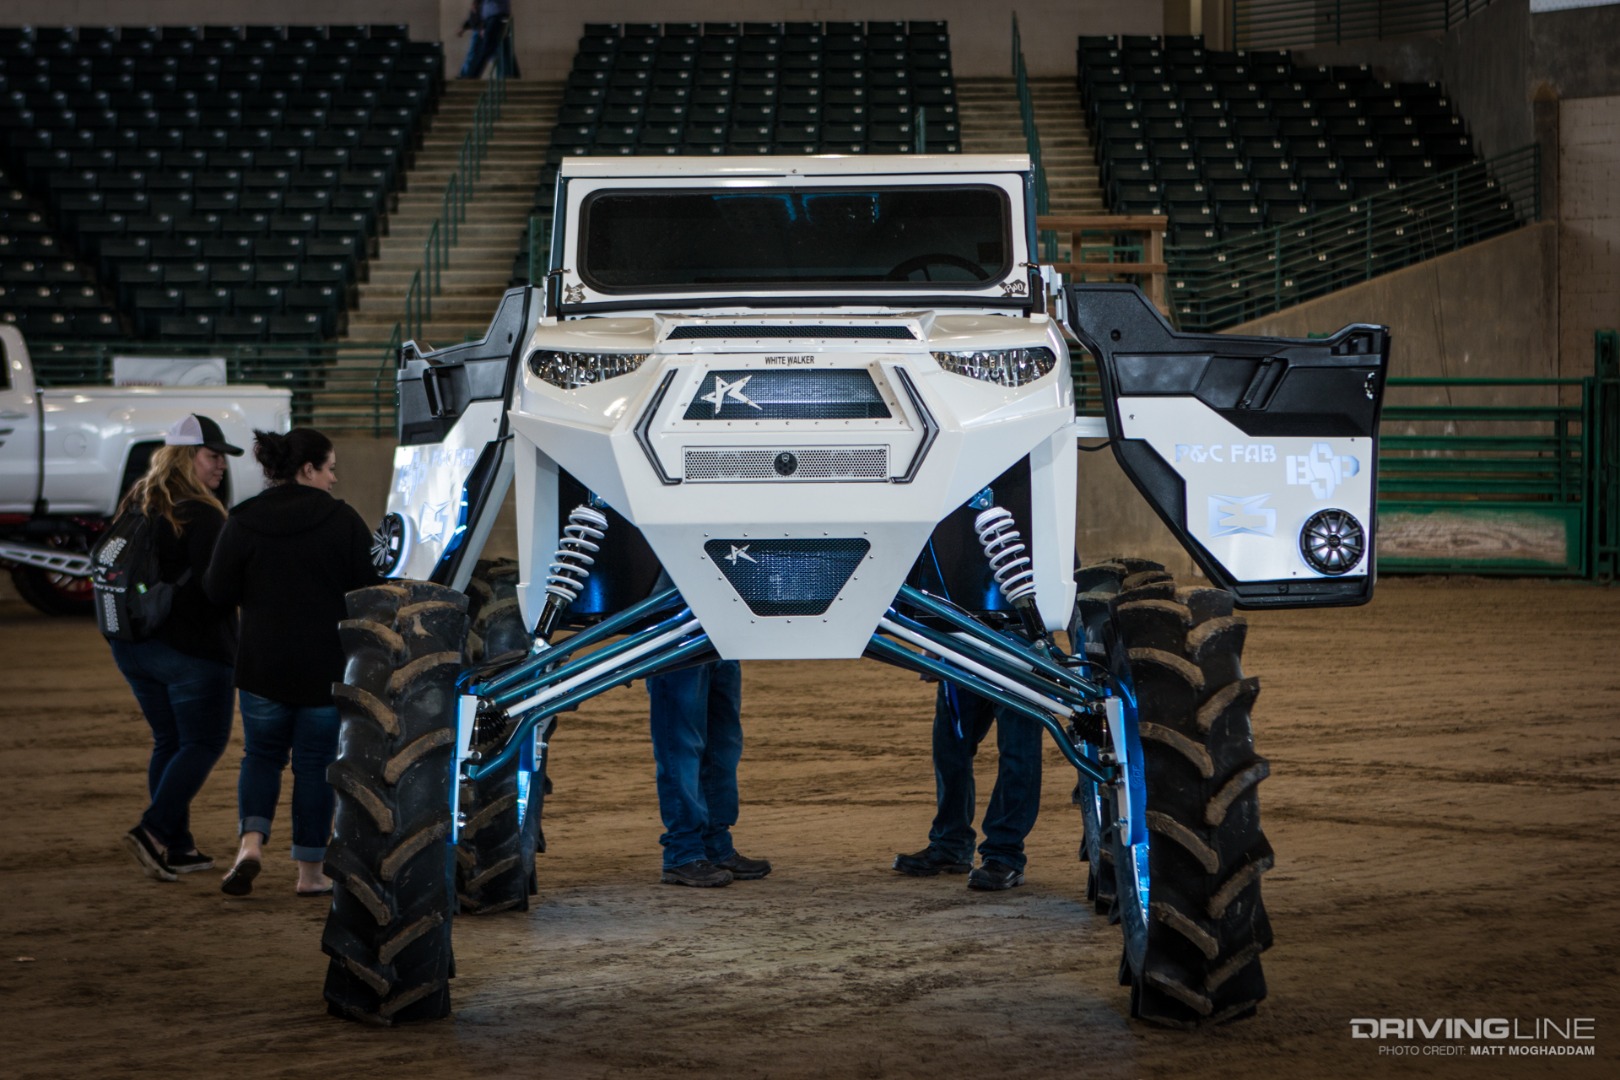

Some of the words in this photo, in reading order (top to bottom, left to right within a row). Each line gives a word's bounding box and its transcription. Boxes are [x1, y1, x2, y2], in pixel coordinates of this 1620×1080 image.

[765, 356, 786, 365] WHITE
[787, 355, 815, 366] WALKER
[1175, 444, 1223, 463] P&C
[1231, 444, 1277, 463] FAB
